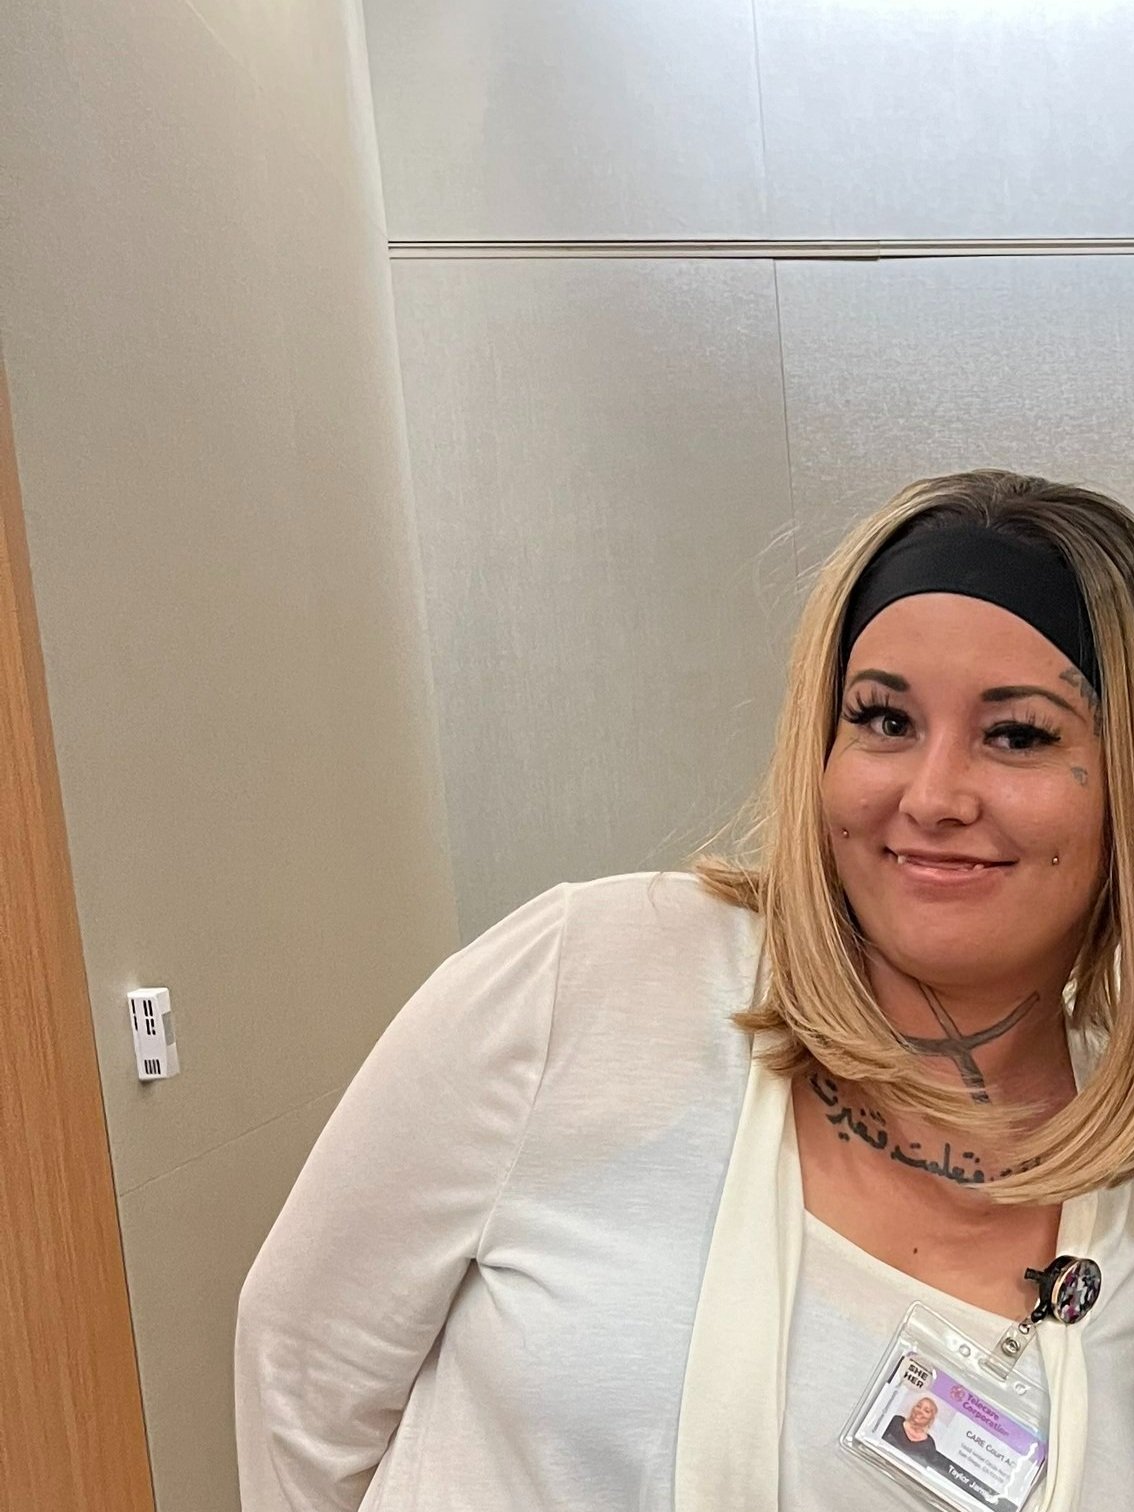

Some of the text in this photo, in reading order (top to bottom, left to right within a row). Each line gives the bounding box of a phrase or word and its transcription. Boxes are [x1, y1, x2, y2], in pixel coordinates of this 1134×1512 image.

[903, 1371, 924, 1389] HER
[908, 1364, 929, 1381] SHE
[966, 1392, 1000, 1420] Telecare
[962, 1401, 1010, 1437] Corporation
[966, 1430, 986, 1448] CARE
[985, 1444, 1005, 1462] Court
[947, 1464, 971, 1485] Taylor
